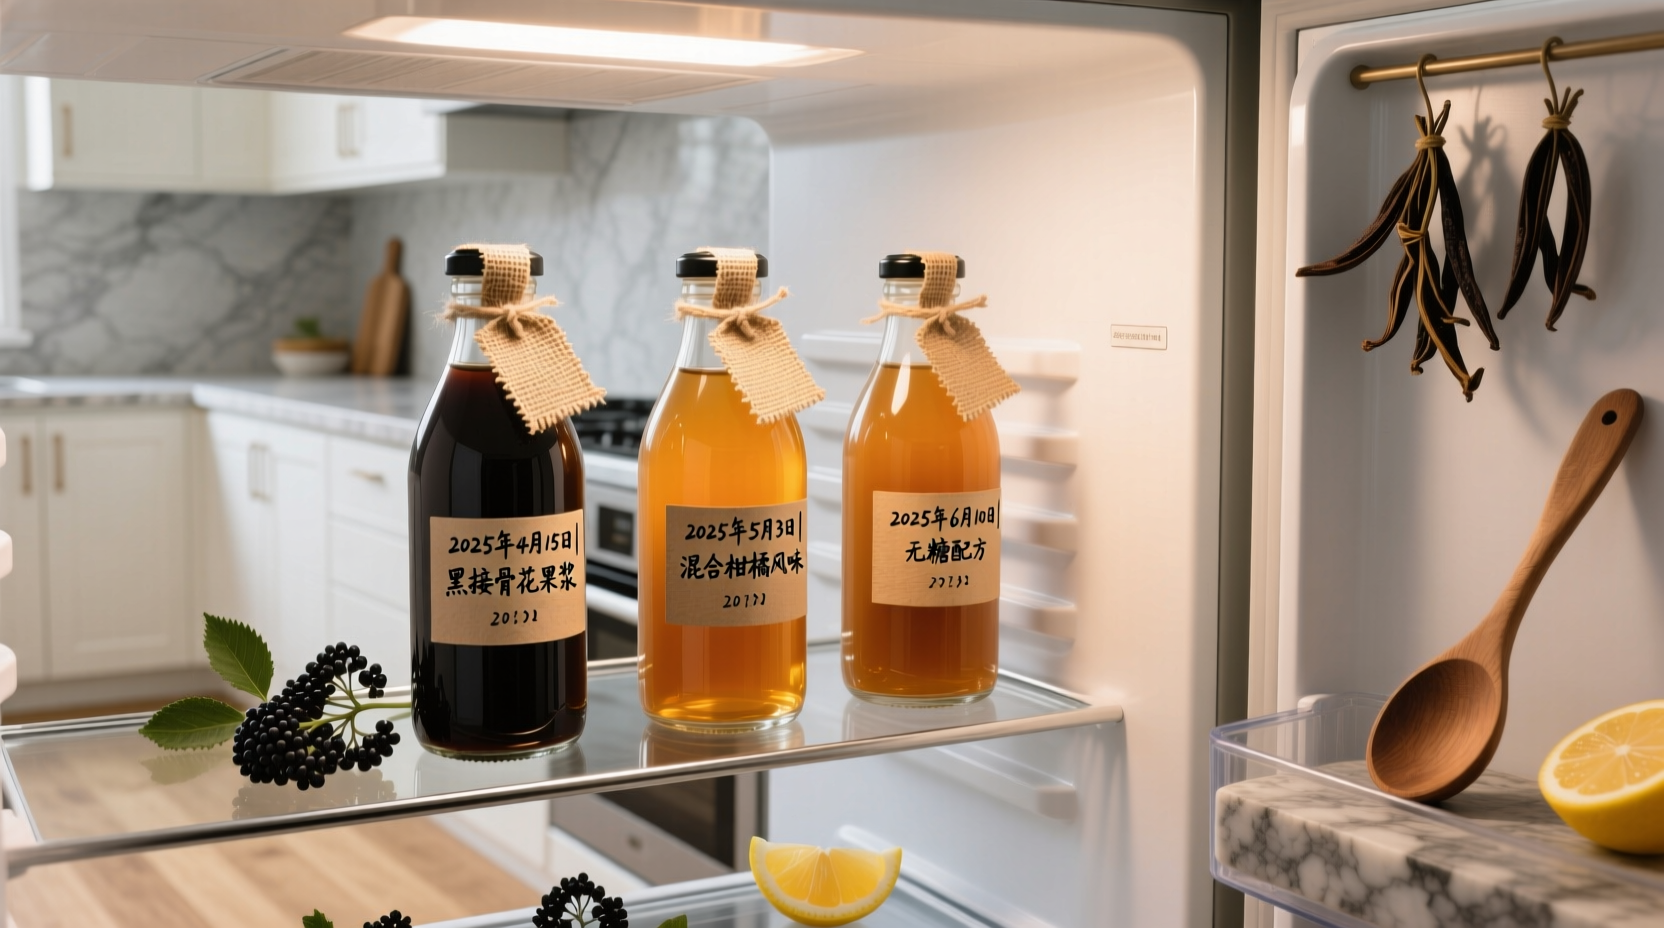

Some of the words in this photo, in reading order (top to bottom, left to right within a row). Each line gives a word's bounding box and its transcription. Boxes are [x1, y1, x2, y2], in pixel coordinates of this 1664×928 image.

[680, 548, 804, 579] 混合柑橘风味
[905, 537, 987, 565] 无糖配方
